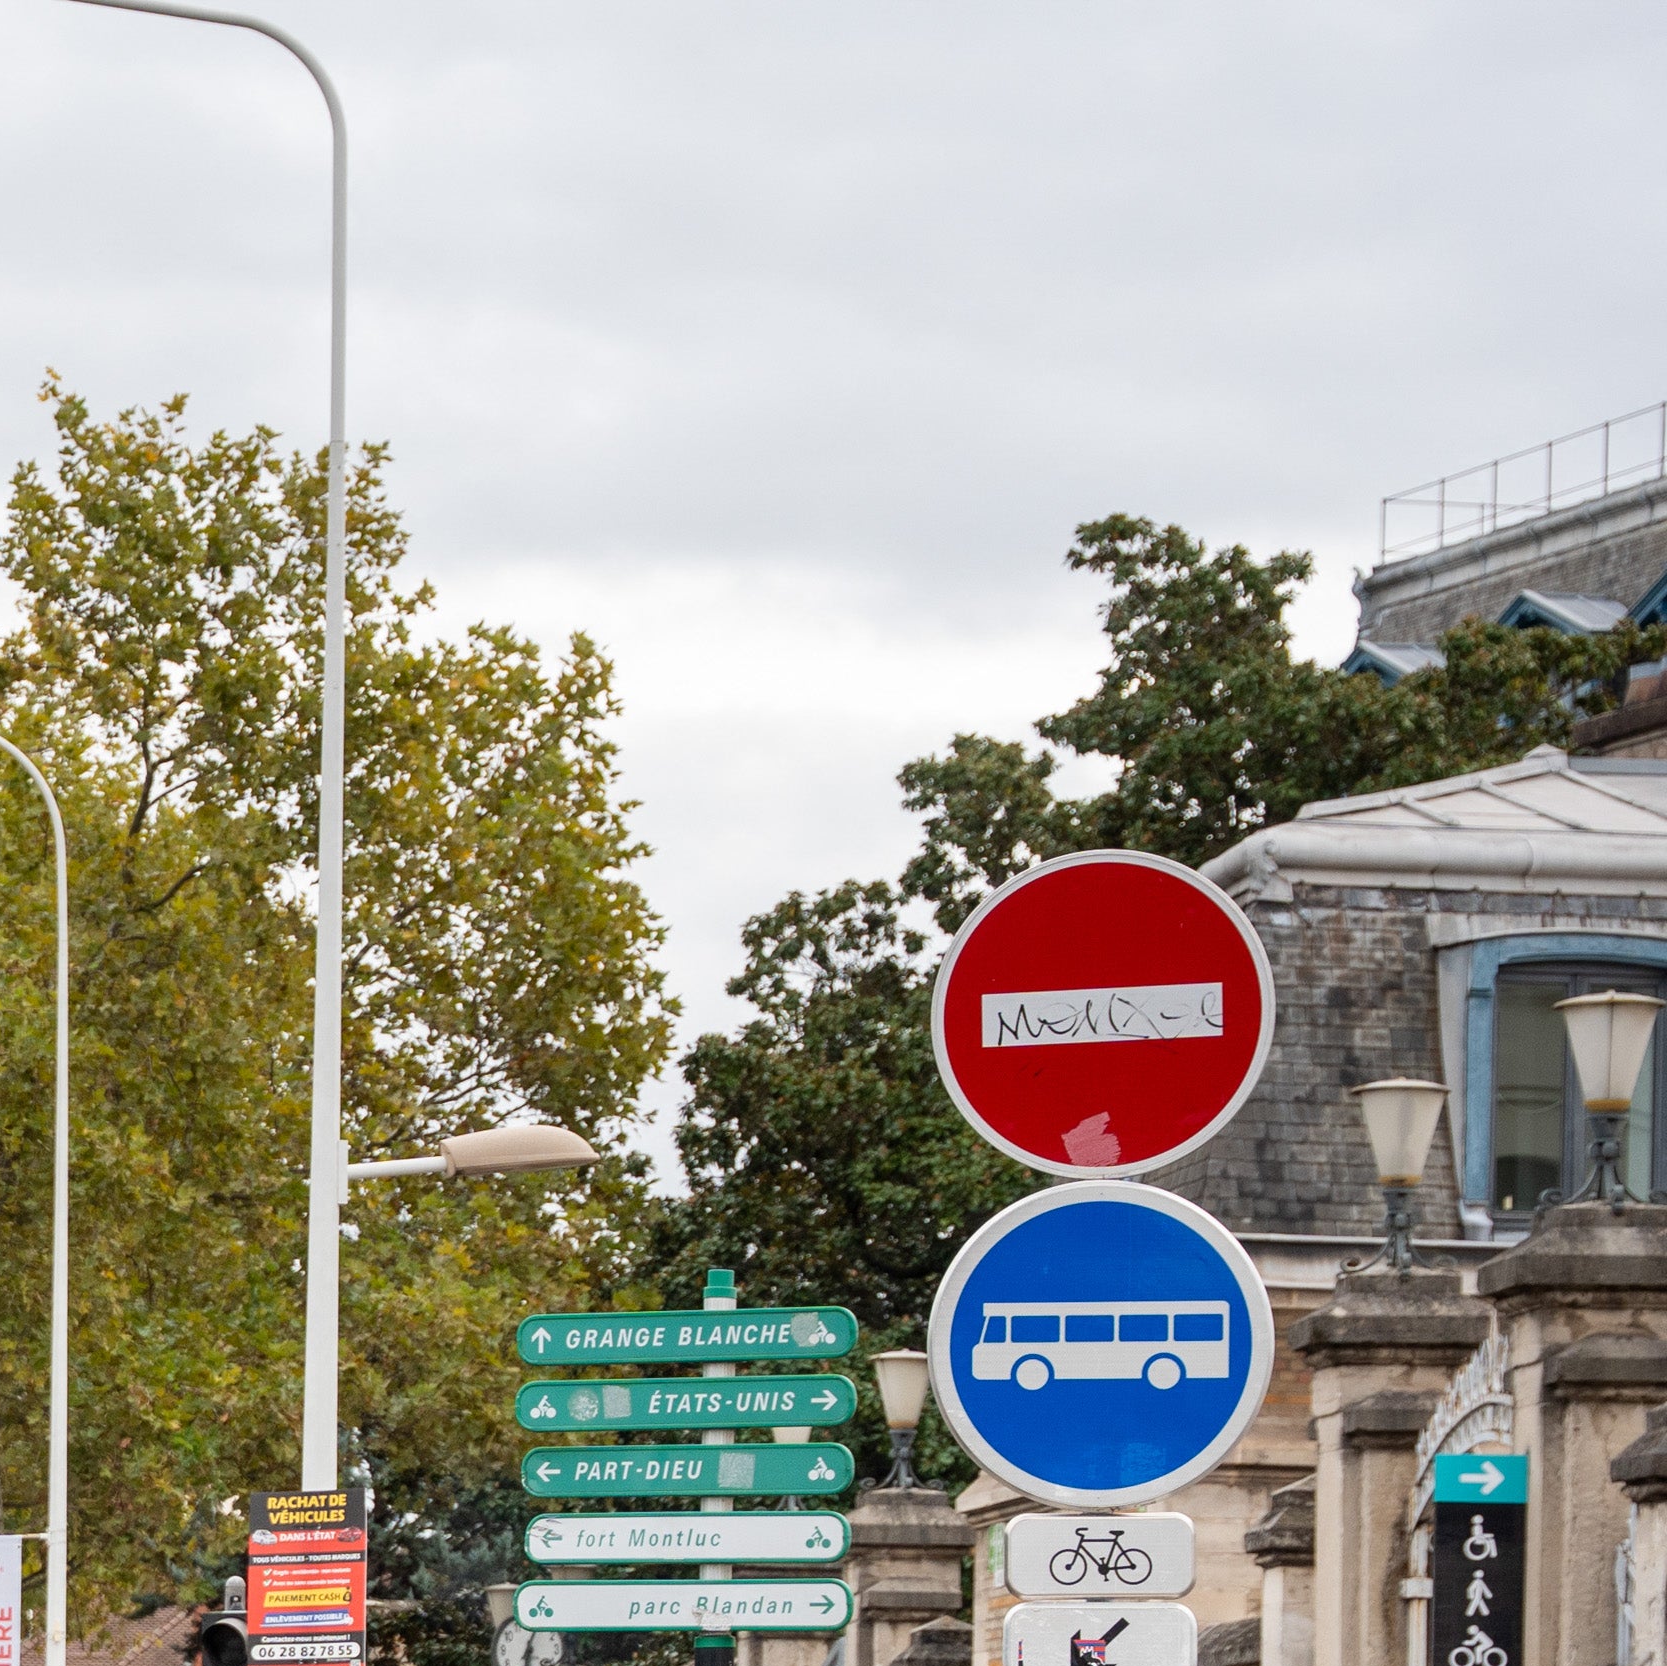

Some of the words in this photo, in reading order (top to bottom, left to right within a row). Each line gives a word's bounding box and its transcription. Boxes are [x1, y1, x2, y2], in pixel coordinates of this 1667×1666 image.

[566, 1326, 665, 1349] GRANGE
[678, 1324, 791, 1346] BLANCHE
[648, 1390, 796, 1414] ÉTATS-UNIS
[574, 1461, 703, 1481] PART-DIEU
[267, 1495, 327, 1509] RACHAT
[328, 1494, 347, 1507] DE
[269, 1509, 345, 1524] VÉHICULES
[279, 1533, 306, 1542] DANS
[307, 1530, 336, 1541] L'ÉTAT
[576, 1529, 616, 1548] fort
[628, 1528, 722, 1548] Montluc
[269, 1594, 316, 1603] PAIEMENT
[628, 1599, 681, 1620] parc
[695, 1595, 793, 1614] Blandan
[259, 1647, 275, 1657] 06
[280, 1647, 296, 1657] 28
[301, 1646, 316, 1657] 82
[320, 1645, 334, 1656] 78
[338, 1645, 353, 1656] 55
